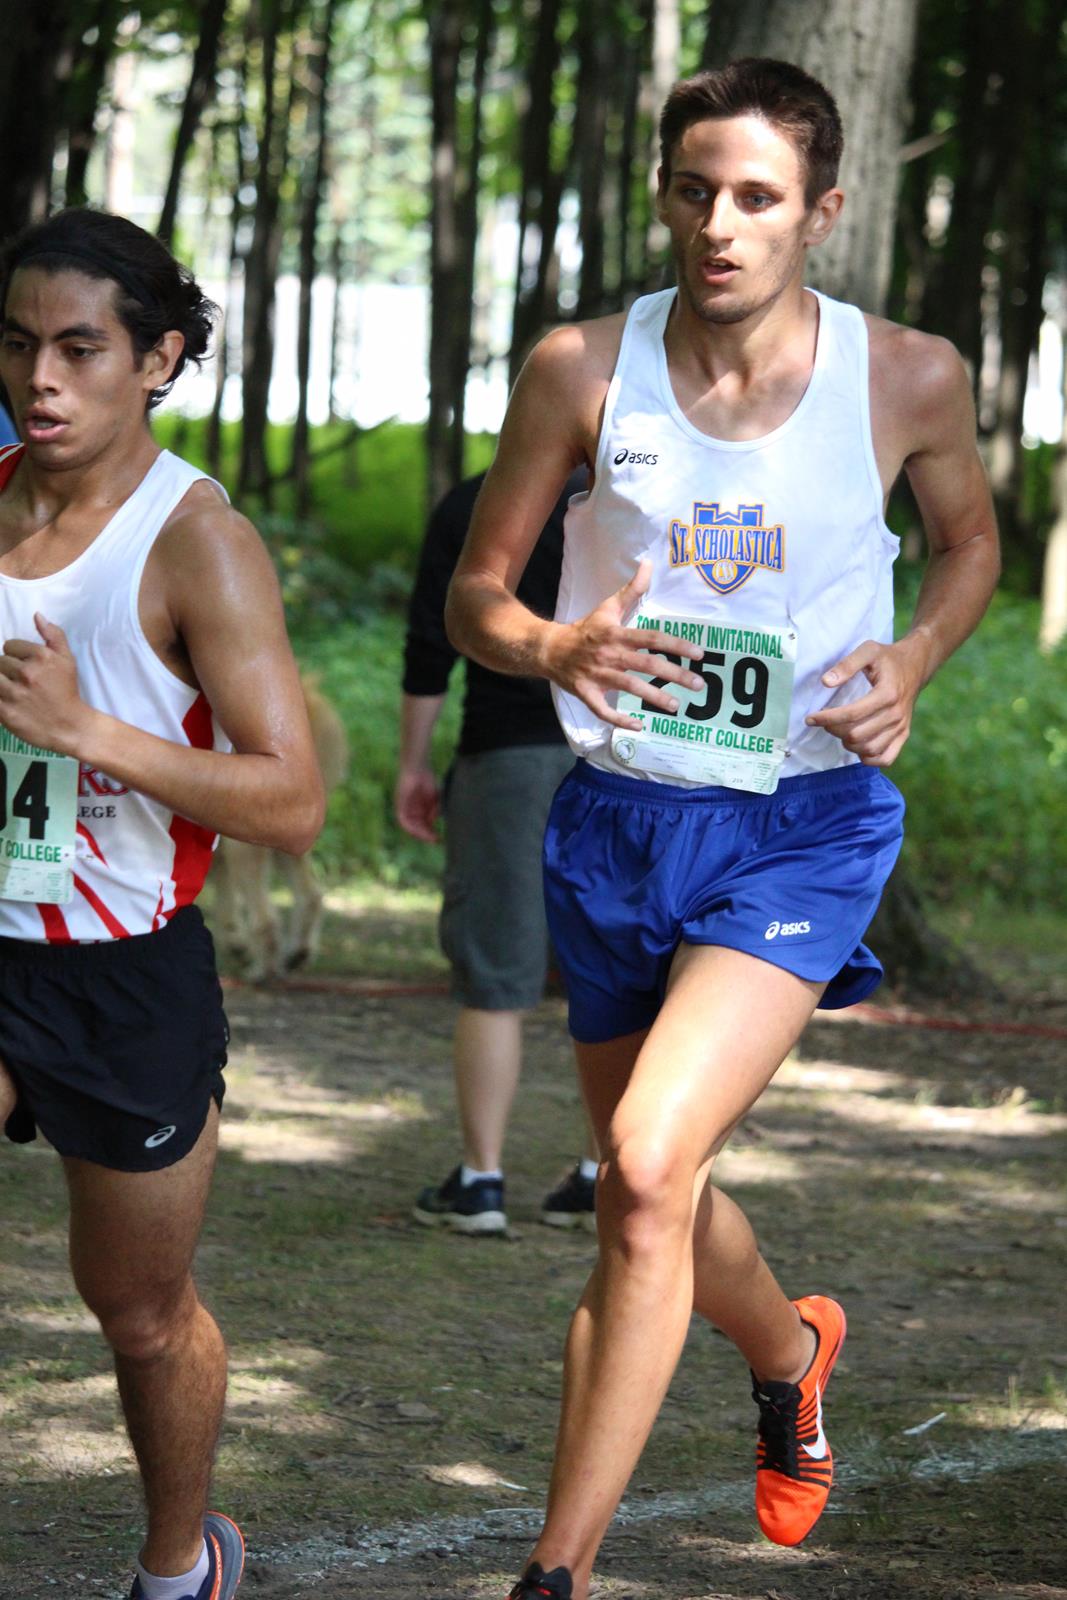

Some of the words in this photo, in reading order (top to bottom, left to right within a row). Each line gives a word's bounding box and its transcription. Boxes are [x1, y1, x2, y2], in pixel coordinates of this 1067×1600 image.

[629, 452, 659, 465] asics
[671, 522, 690, 565] ST.
[694, 527, 783, 571] SCHOLASTICA
[664, 621, 704, 646] BARRY
[707, 626, 783, 660] INVITATIONAL
[651, 717, 713, 745] NORBERT
[715, 730, 774, 754] COLLEGE
[5, 840, 62, 863] COLLEGE
[780, 920, 811, 936] asics
